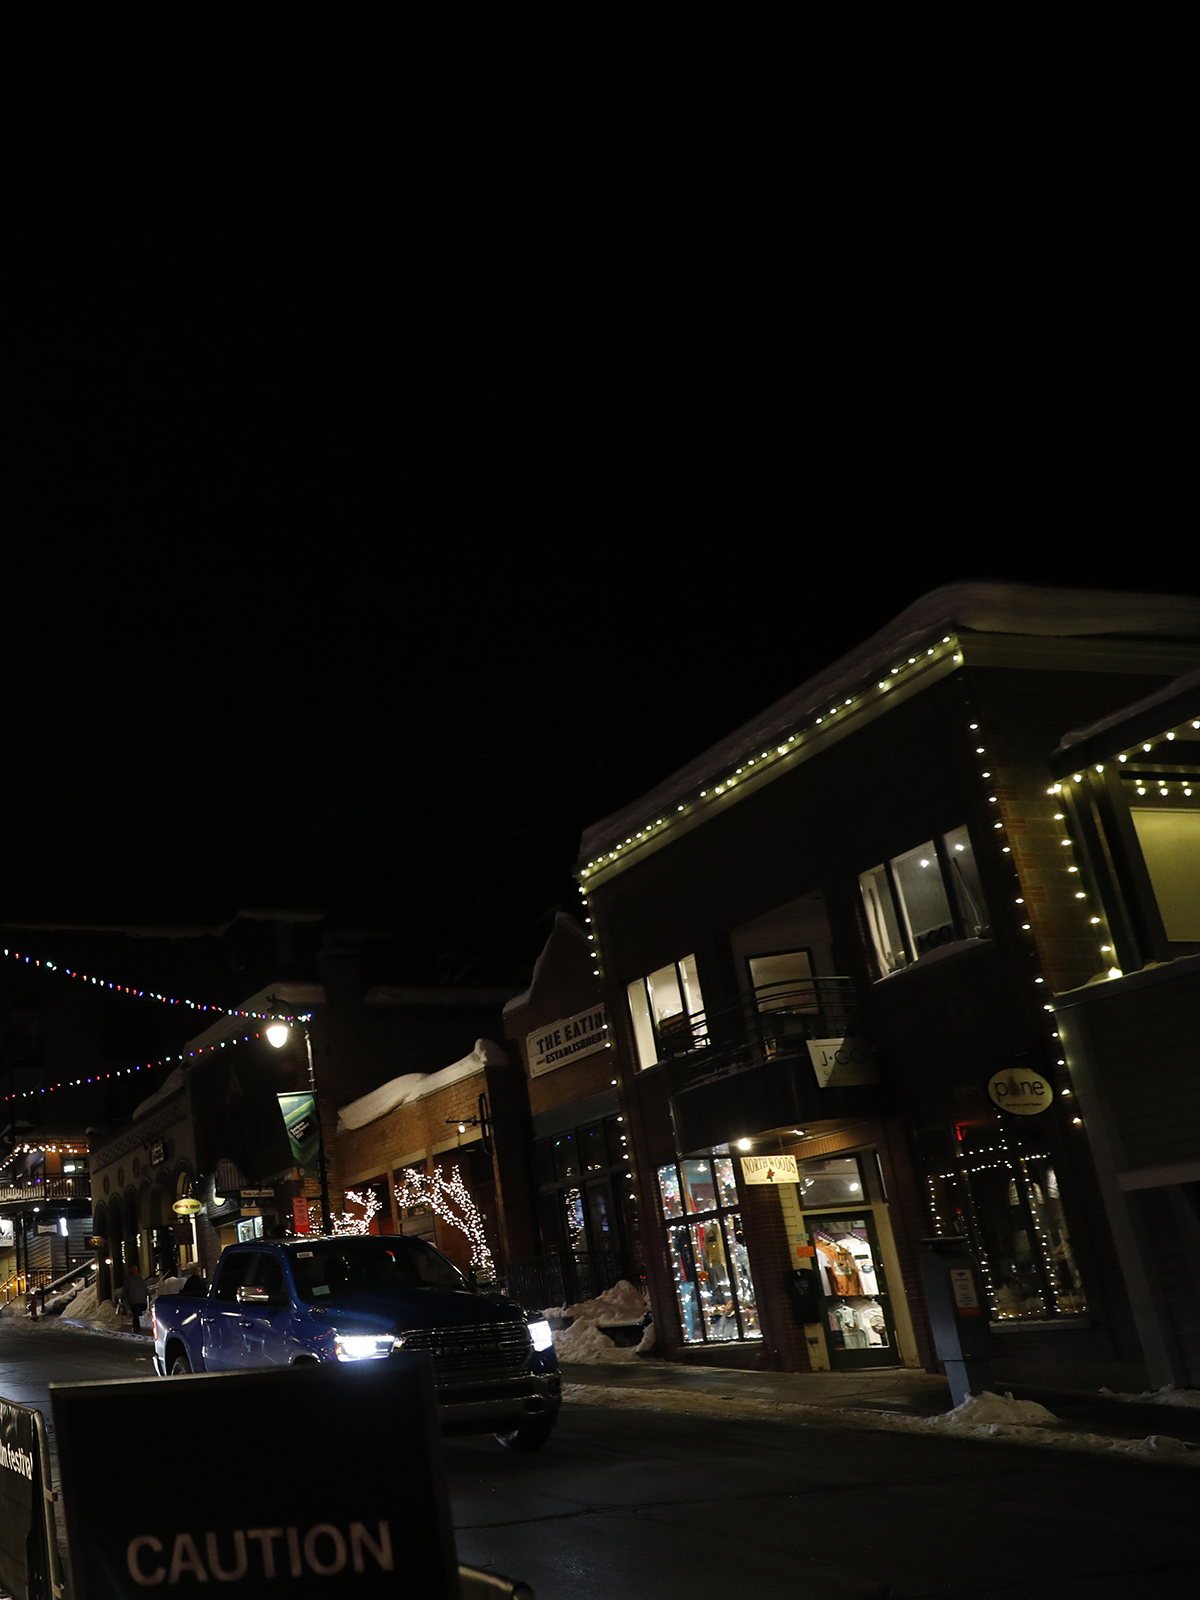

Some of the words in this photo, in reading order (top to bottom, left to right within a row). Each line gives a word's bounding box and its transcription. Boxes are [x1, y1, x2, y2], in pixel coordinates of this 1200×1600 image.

[536, 1029, 561, 1055] THE
[564, 1011, 603, 1041] EATIN
[545, 1031, 607, 1064] ESTABLISHMENT
[126, 1519, 395, 1587] CAUTION
